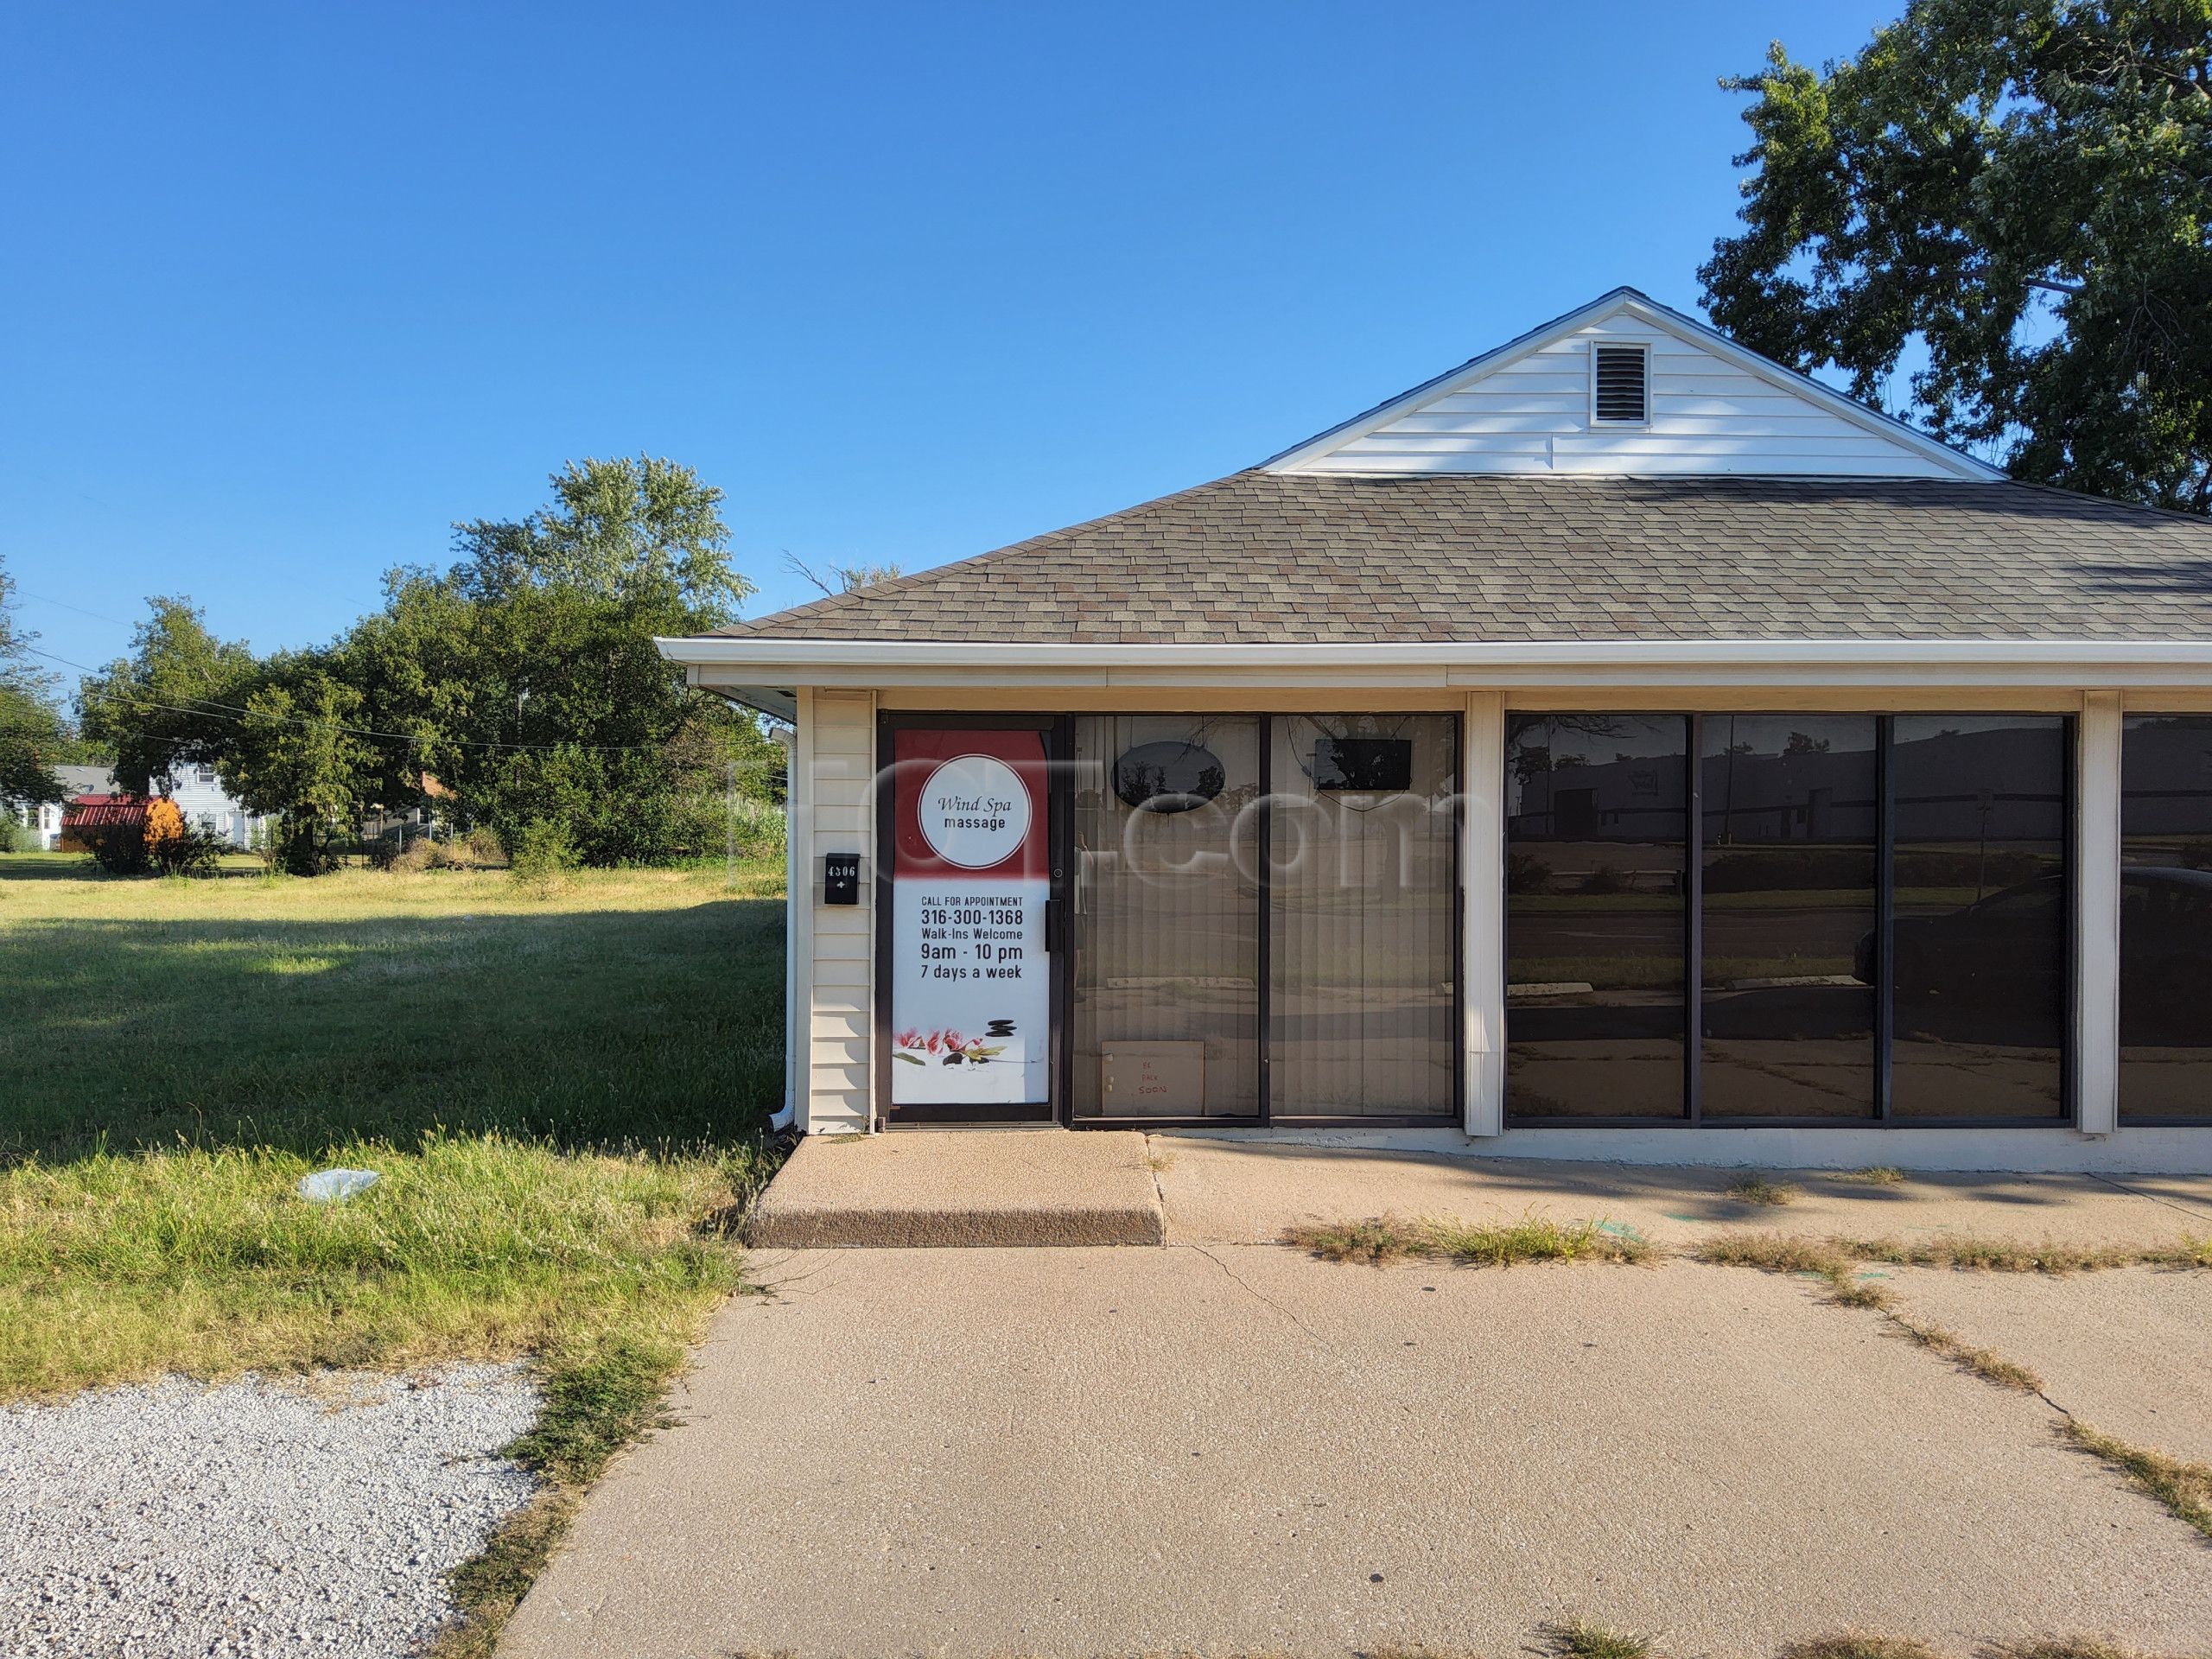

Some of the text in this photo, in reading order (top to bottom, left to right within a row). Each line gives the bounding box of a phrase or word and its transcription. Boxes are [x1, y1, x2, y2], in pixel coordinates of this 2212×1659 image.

[938, 796, 1012, 817] Wind Spa
[944, 817, 1005, 831] massage
[829, 867, 855, 876] 4306
[922, 897, 1023, 906] CALL FOR APPOINTMENT
[922, 909, 1023, 925] 316-300-1368
[922, 928, 1023, 939] Walk-Ins Welcome
[921, 944, 956, 959] 9am
[976, 944, 991, 959] 10
[999, 947, 1022, 963] pm
[921, 964, 1021, 982] 7 days a week
